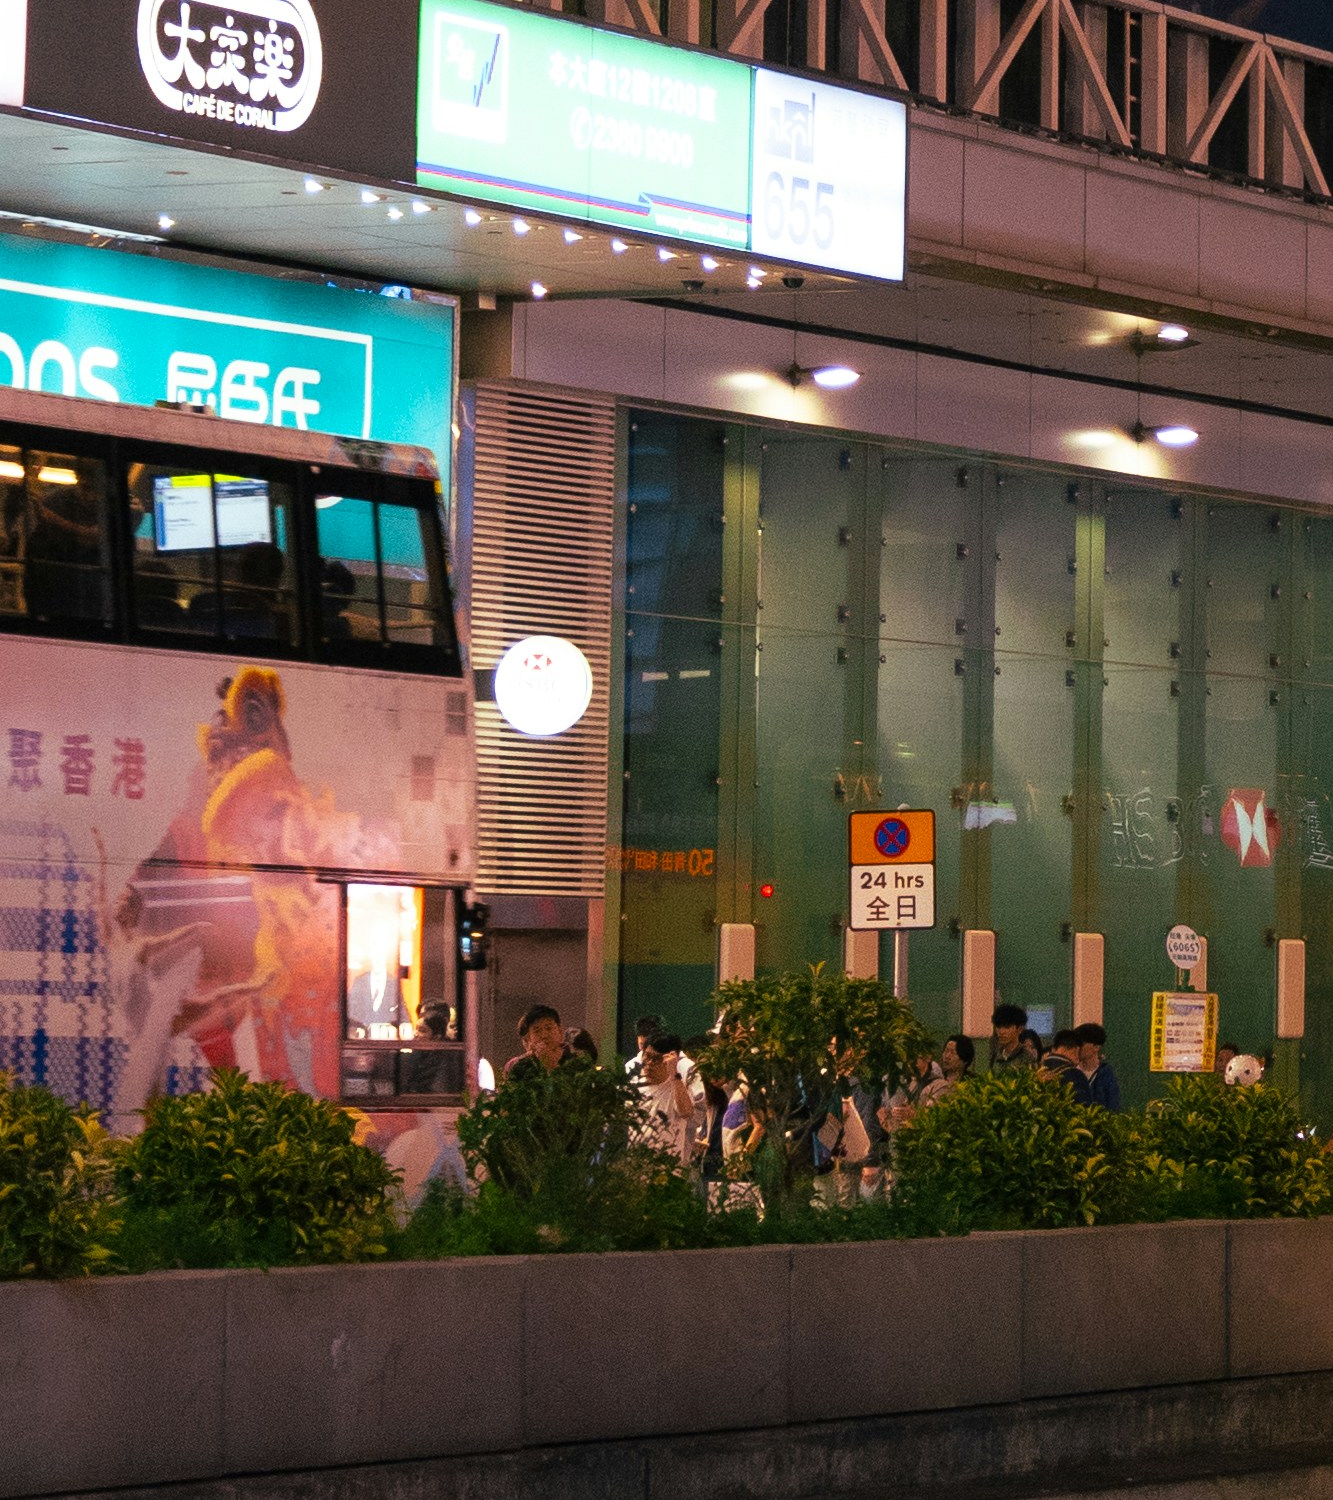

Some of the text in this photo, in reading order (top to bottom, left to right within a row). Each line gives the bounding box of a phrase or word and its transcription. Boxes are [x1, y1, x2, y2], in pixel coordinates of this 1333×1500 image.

[182, 92, 277, 129] CAFÉ DE CORAL
[762, 169, 835, 252] 655
[859, 870, 925, 891] 24 hrs
[865, 894, 918, 923] 全日
